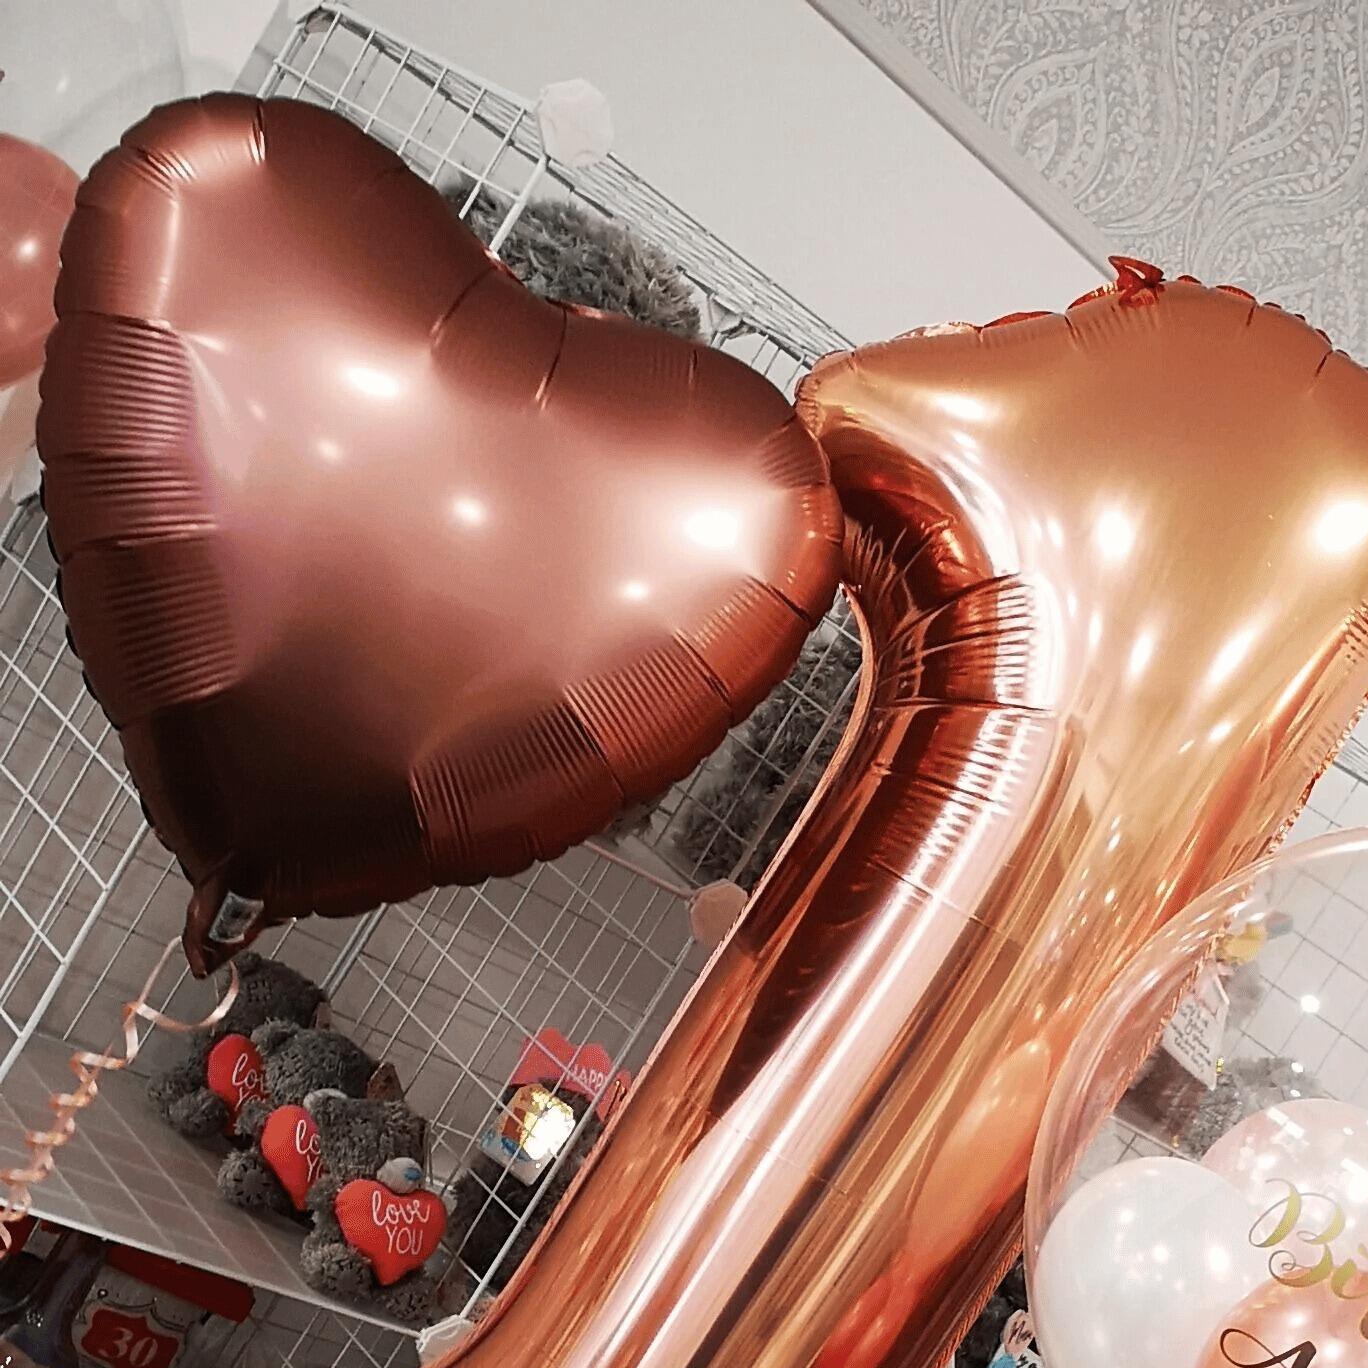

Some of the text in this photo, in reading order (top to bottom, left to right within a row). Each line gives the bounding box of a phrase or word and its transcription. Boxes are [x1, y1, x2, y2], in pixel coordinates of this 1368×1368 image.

[371, 1190, 431, 1226] love
[384, 1226, 424, 1256] YOU
[98, 1326, 159, 1367] 30
